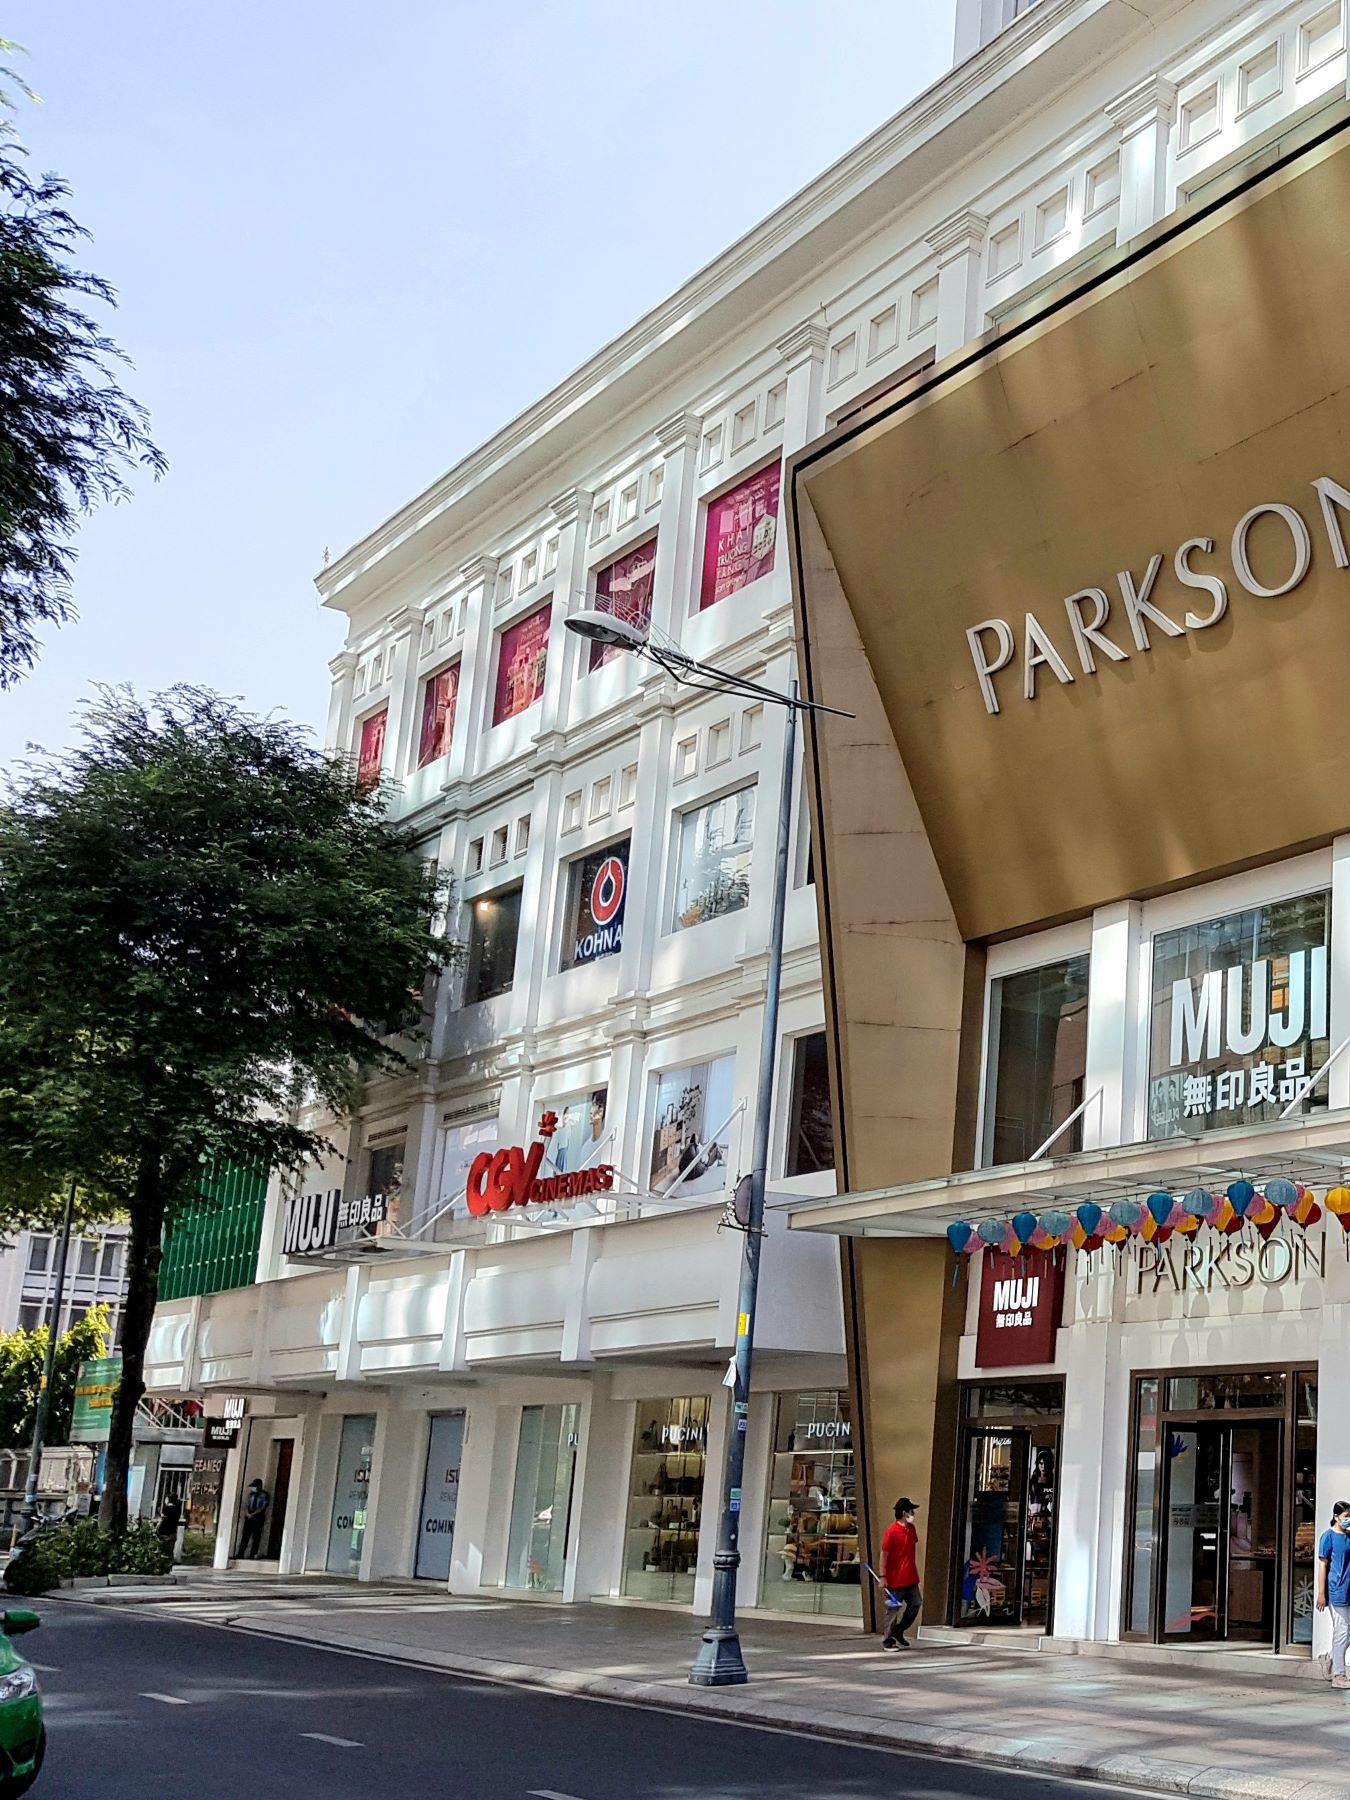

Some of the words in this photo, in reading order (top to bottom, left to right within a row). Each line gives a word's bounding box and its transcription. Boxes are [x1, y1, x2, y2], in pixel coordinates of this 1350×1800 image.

[1170, 945, 1328, 1067] MUJI
[1183, 1056, 1312, 1118] 無印良品
[466, 1141, 545, 1217] CGV
[529, 1163, 614, 1204] CINEMAS
[281, 1189, 337, 1254] MUJI
[338, 1193, 383, 1228] 無印良品
[993, 1276, 1040, 1311] MUJI
[1137, 1231, 1326, 1295] PARKSON
[996, 1310, 1033, 1329] 無印良品
[224, 1398, 245, 1418] MUJI
[661, 1424, 704, 1444] PUCINI
